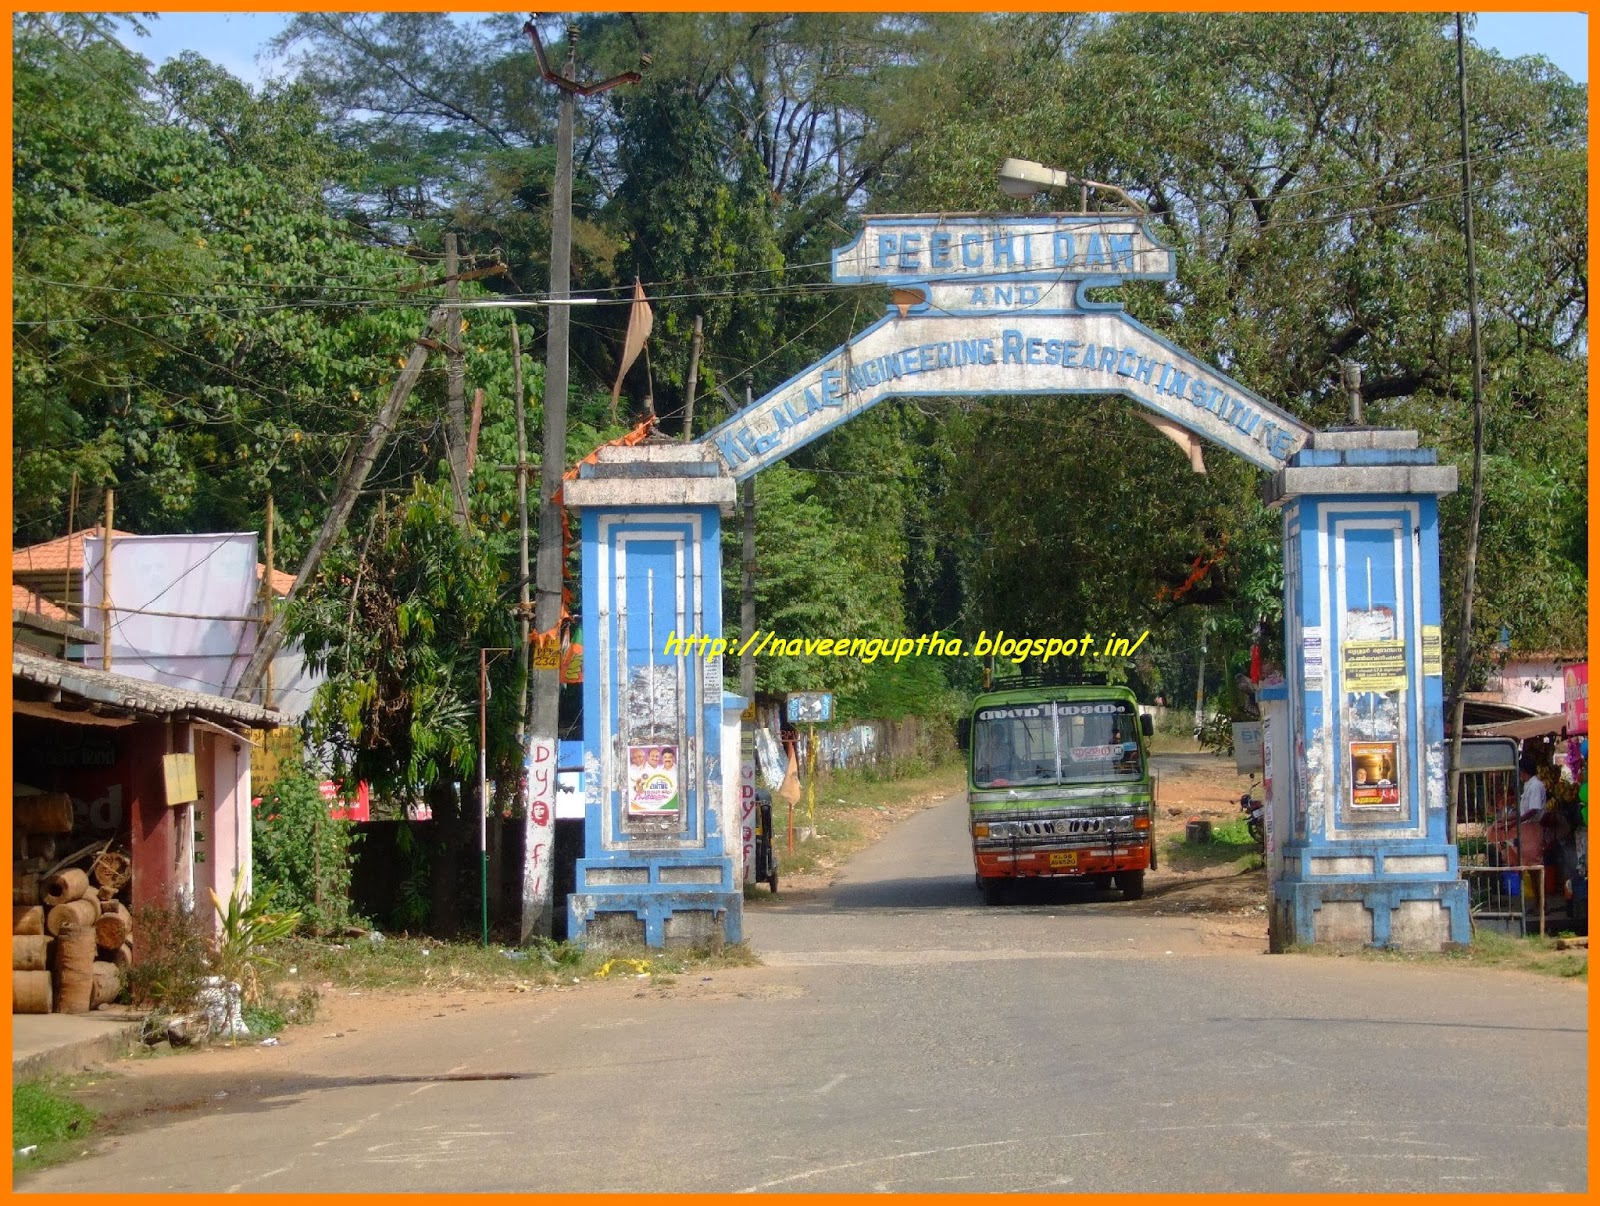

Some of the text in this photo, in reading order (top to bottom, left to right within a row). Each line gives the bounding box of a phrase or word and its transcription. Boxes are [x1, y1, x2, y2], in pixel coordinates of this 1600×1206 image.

[878, 231, 1134, 270] PEECHI DAM
[969, 286, 1040, 306] AND
[535, 656, 557, 667] 234
